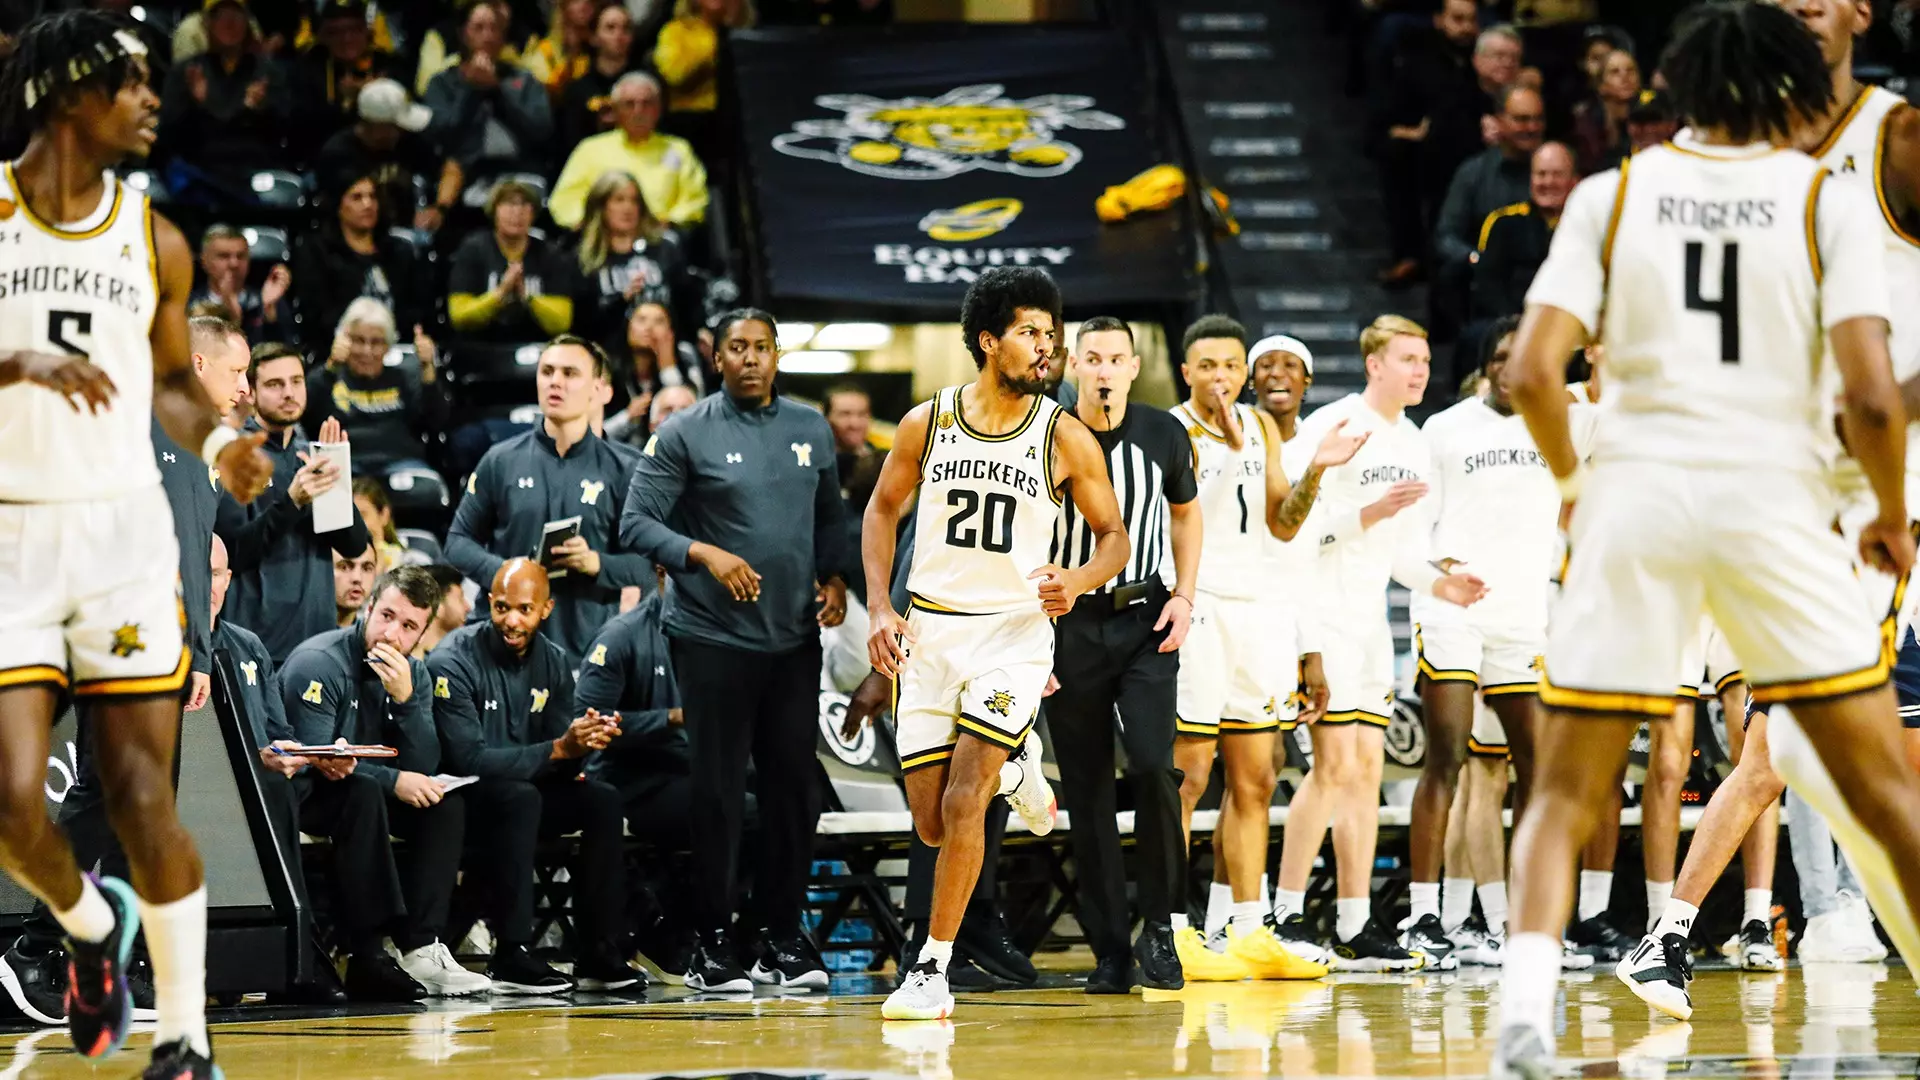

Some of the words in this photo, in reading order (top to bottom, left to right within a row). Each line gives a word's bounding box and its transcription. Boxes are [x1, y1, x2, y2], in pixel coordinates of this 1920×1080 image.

[1657, 197, 1776, 230] ROGERS
[875, 244, 1072, 266] EQUITY
[0, 265, 141, 314] SHOCKERS
[1685, 241, 1740, 364] 4
[931, 459, 1039, 498] SHOCKERS
[1464, 449, 1548, 474] SHOCKERS
[945, 488, 1017, 554] 20
[1237, 484, 1248, 533] 1
